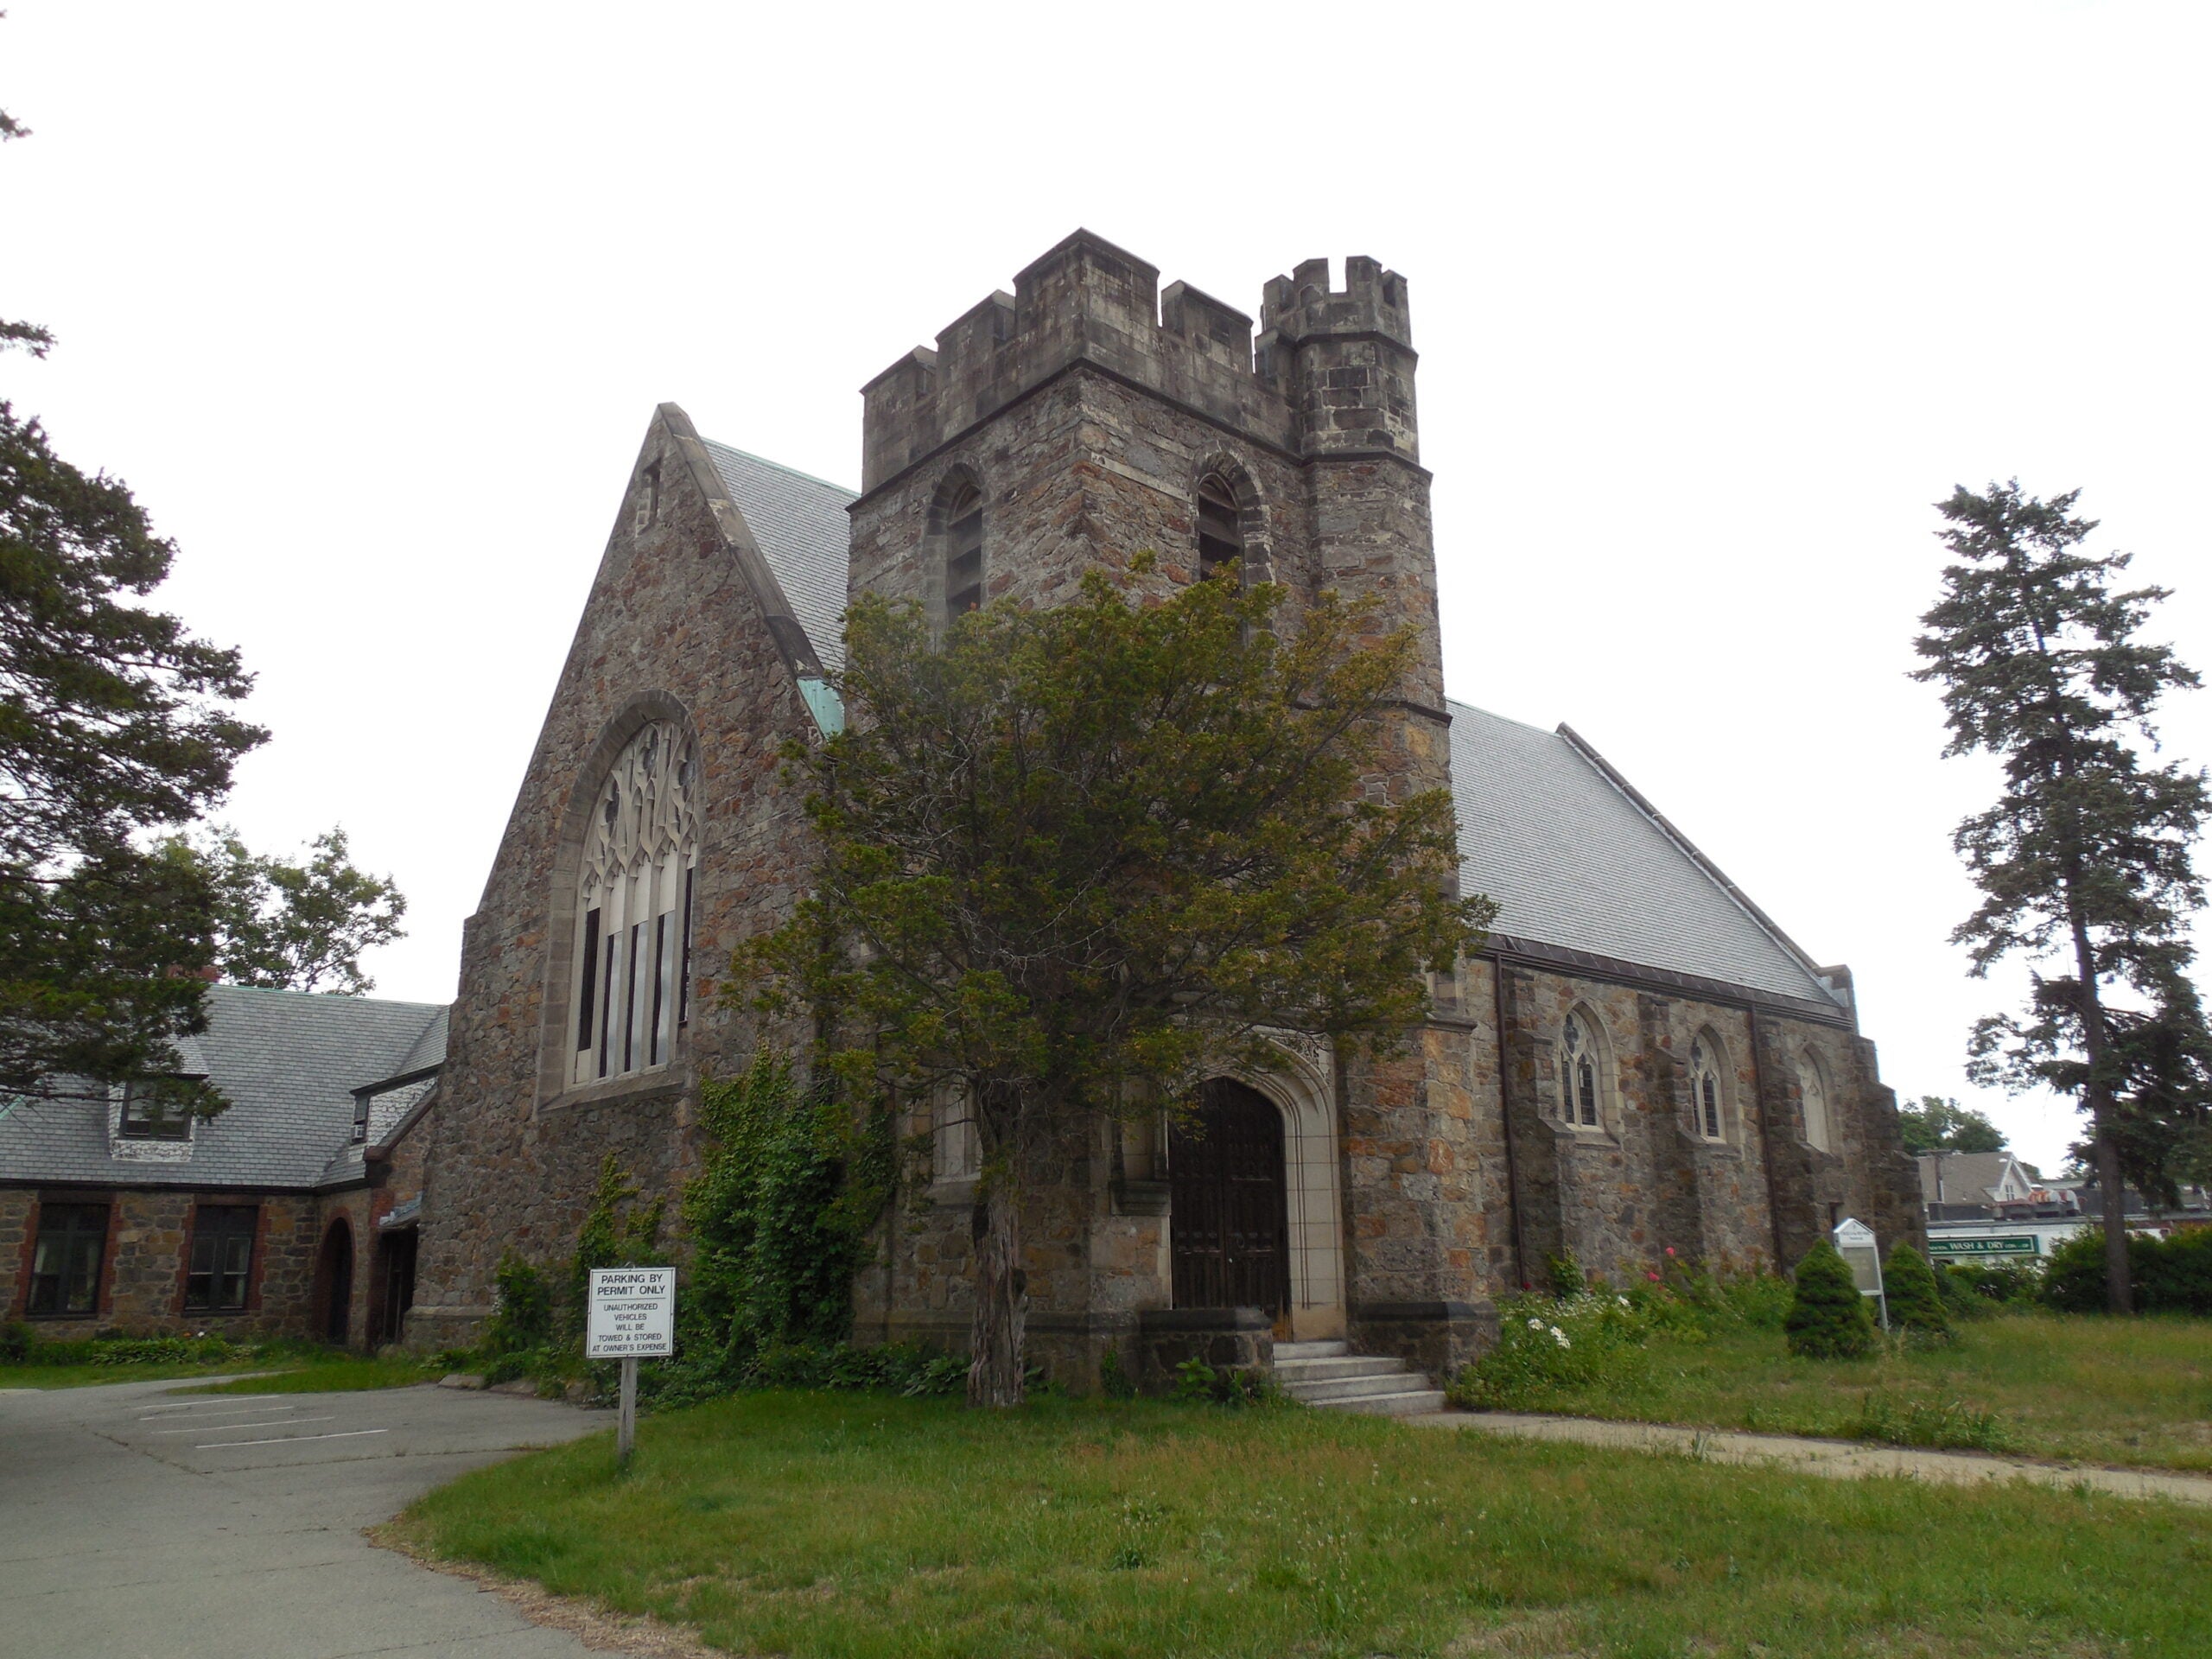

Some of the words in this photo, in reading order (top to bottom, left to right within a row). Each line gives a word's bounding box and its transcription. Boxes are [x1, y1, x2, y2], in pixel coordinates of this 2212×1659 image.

[601, 1274, 645, 1284] PARKING
[650, 1274, 663, 1282] BY
[597, 1286, 634, 1295] PERMIT
[639, 1285, 665, 1294] ONLY
[604, 1303, 658, 1312] UNAUTHORIZED
